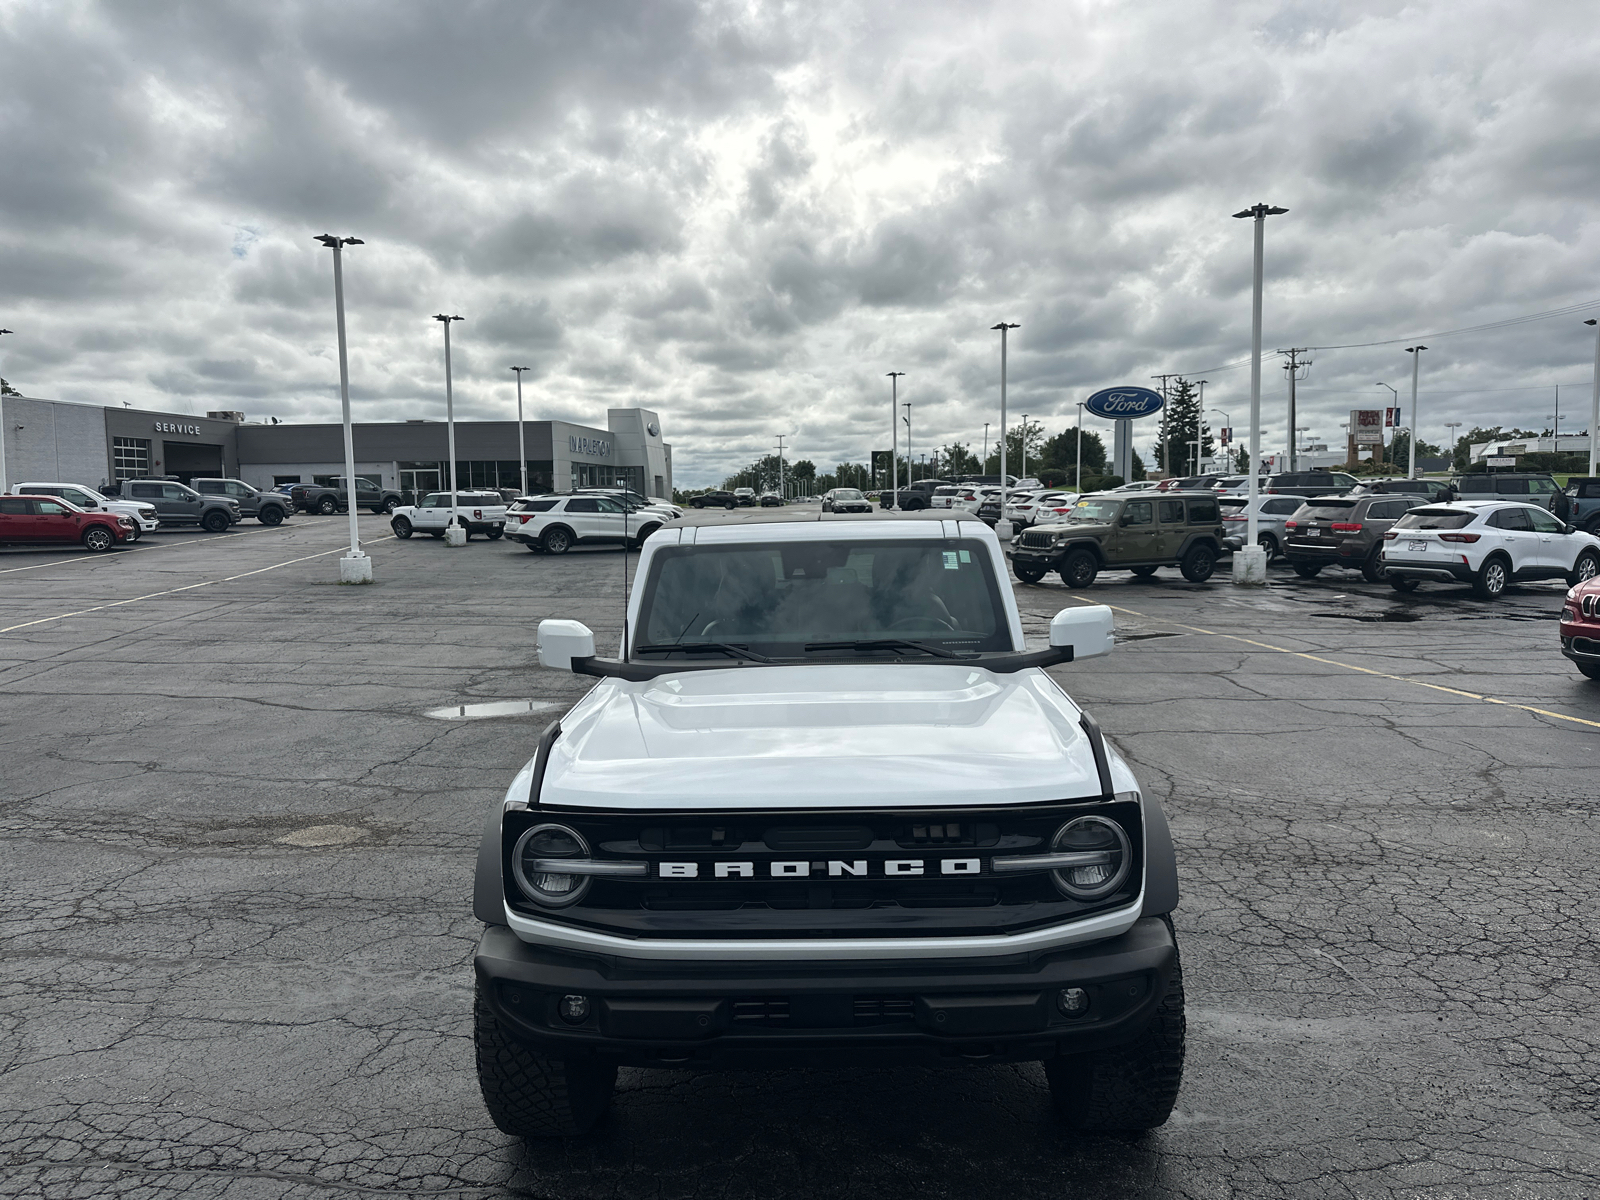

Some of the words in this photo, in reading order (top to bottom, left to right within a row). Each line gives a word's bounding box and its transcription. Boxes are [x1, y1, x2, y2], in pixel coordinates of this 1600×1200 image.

[1103, 392, 1149, 412] Ford
[155, 422, 201, 435] SERVICE
[570, 435, 611, 457] NAPLETON
[658, 858, 981, 877] BRONCO
